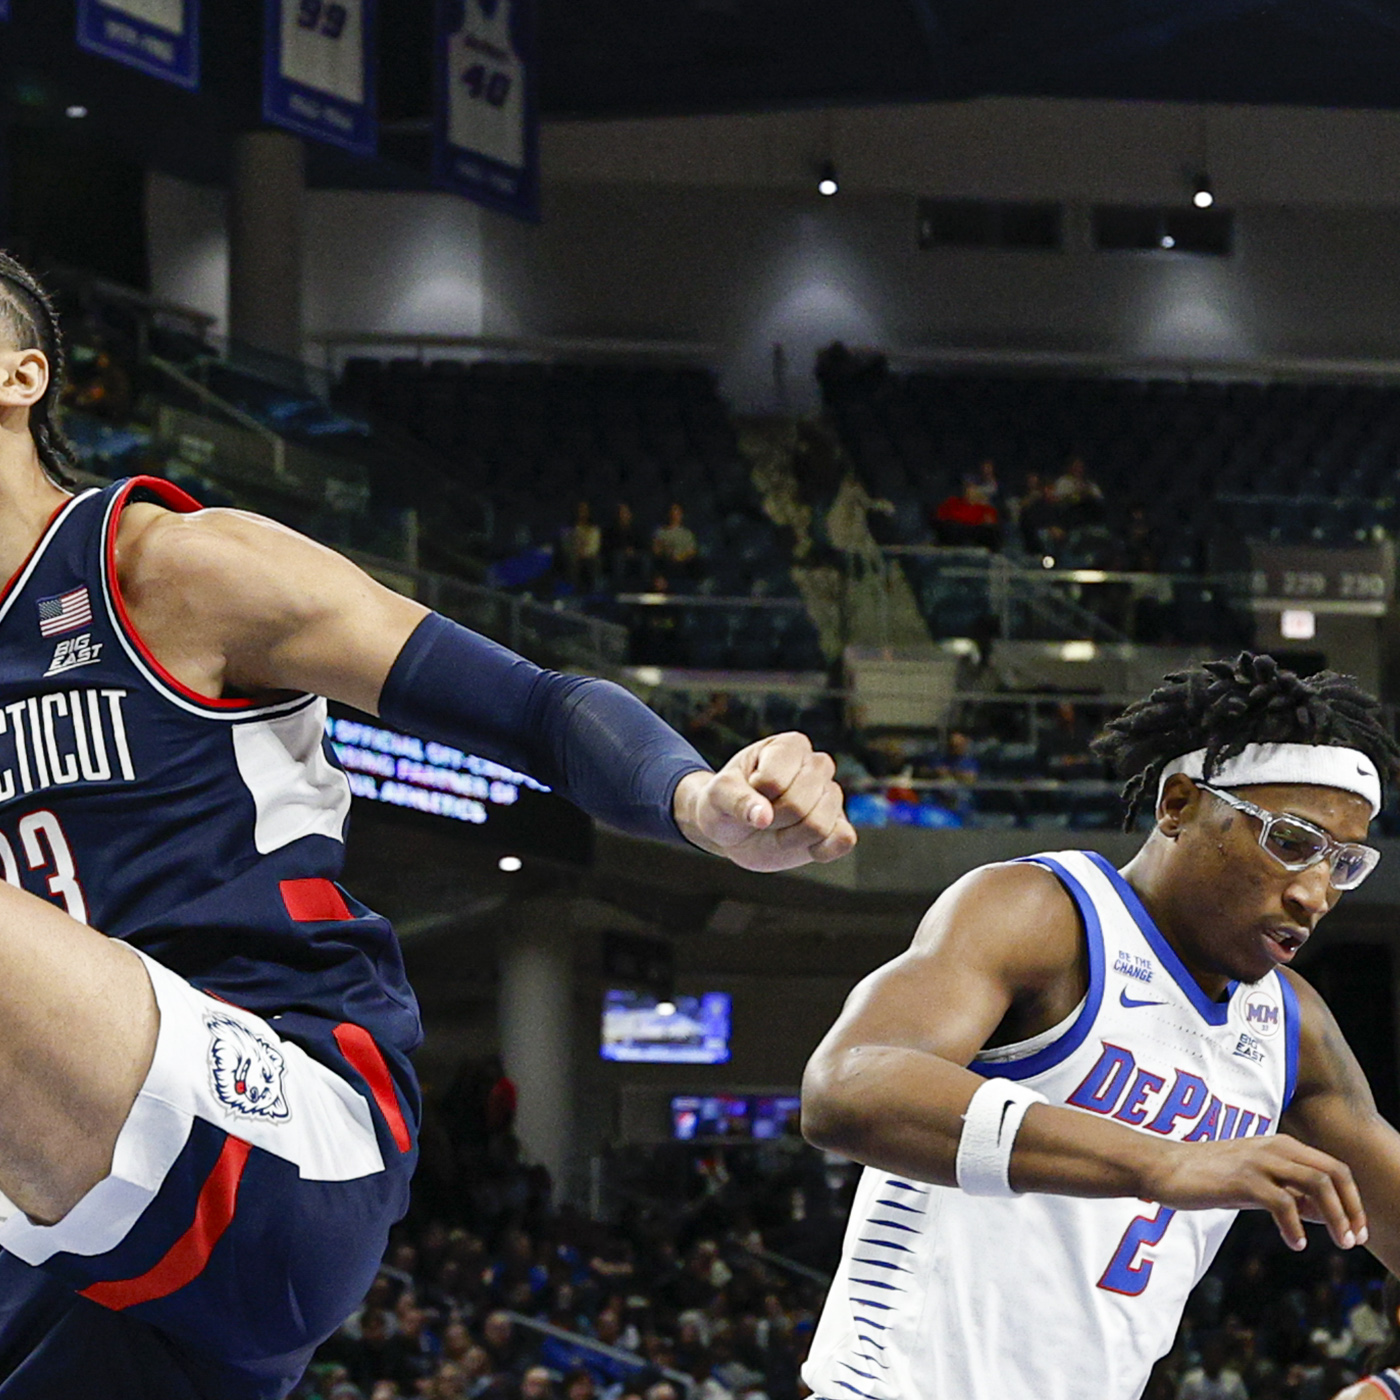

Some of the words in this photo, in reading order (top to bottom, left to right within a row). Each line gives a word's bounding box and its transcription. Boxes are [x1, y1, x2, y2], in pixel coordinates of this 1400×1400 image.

[49, 643, 103, 671] EAST
[54, 633, 91, 657] BIG
[1113, 959, 1154, 984] CHANGE
[1118, 949, 1131, 962] BE
[1134, 955, 1152, 970] THE
[1246, 1002, 1279, 1026] MM
[1236, 1042, 1266, 1064] EAST
[1239, 1033, 1258, 1050] BIG
[1096, 1198, 1177, 1297] 2
